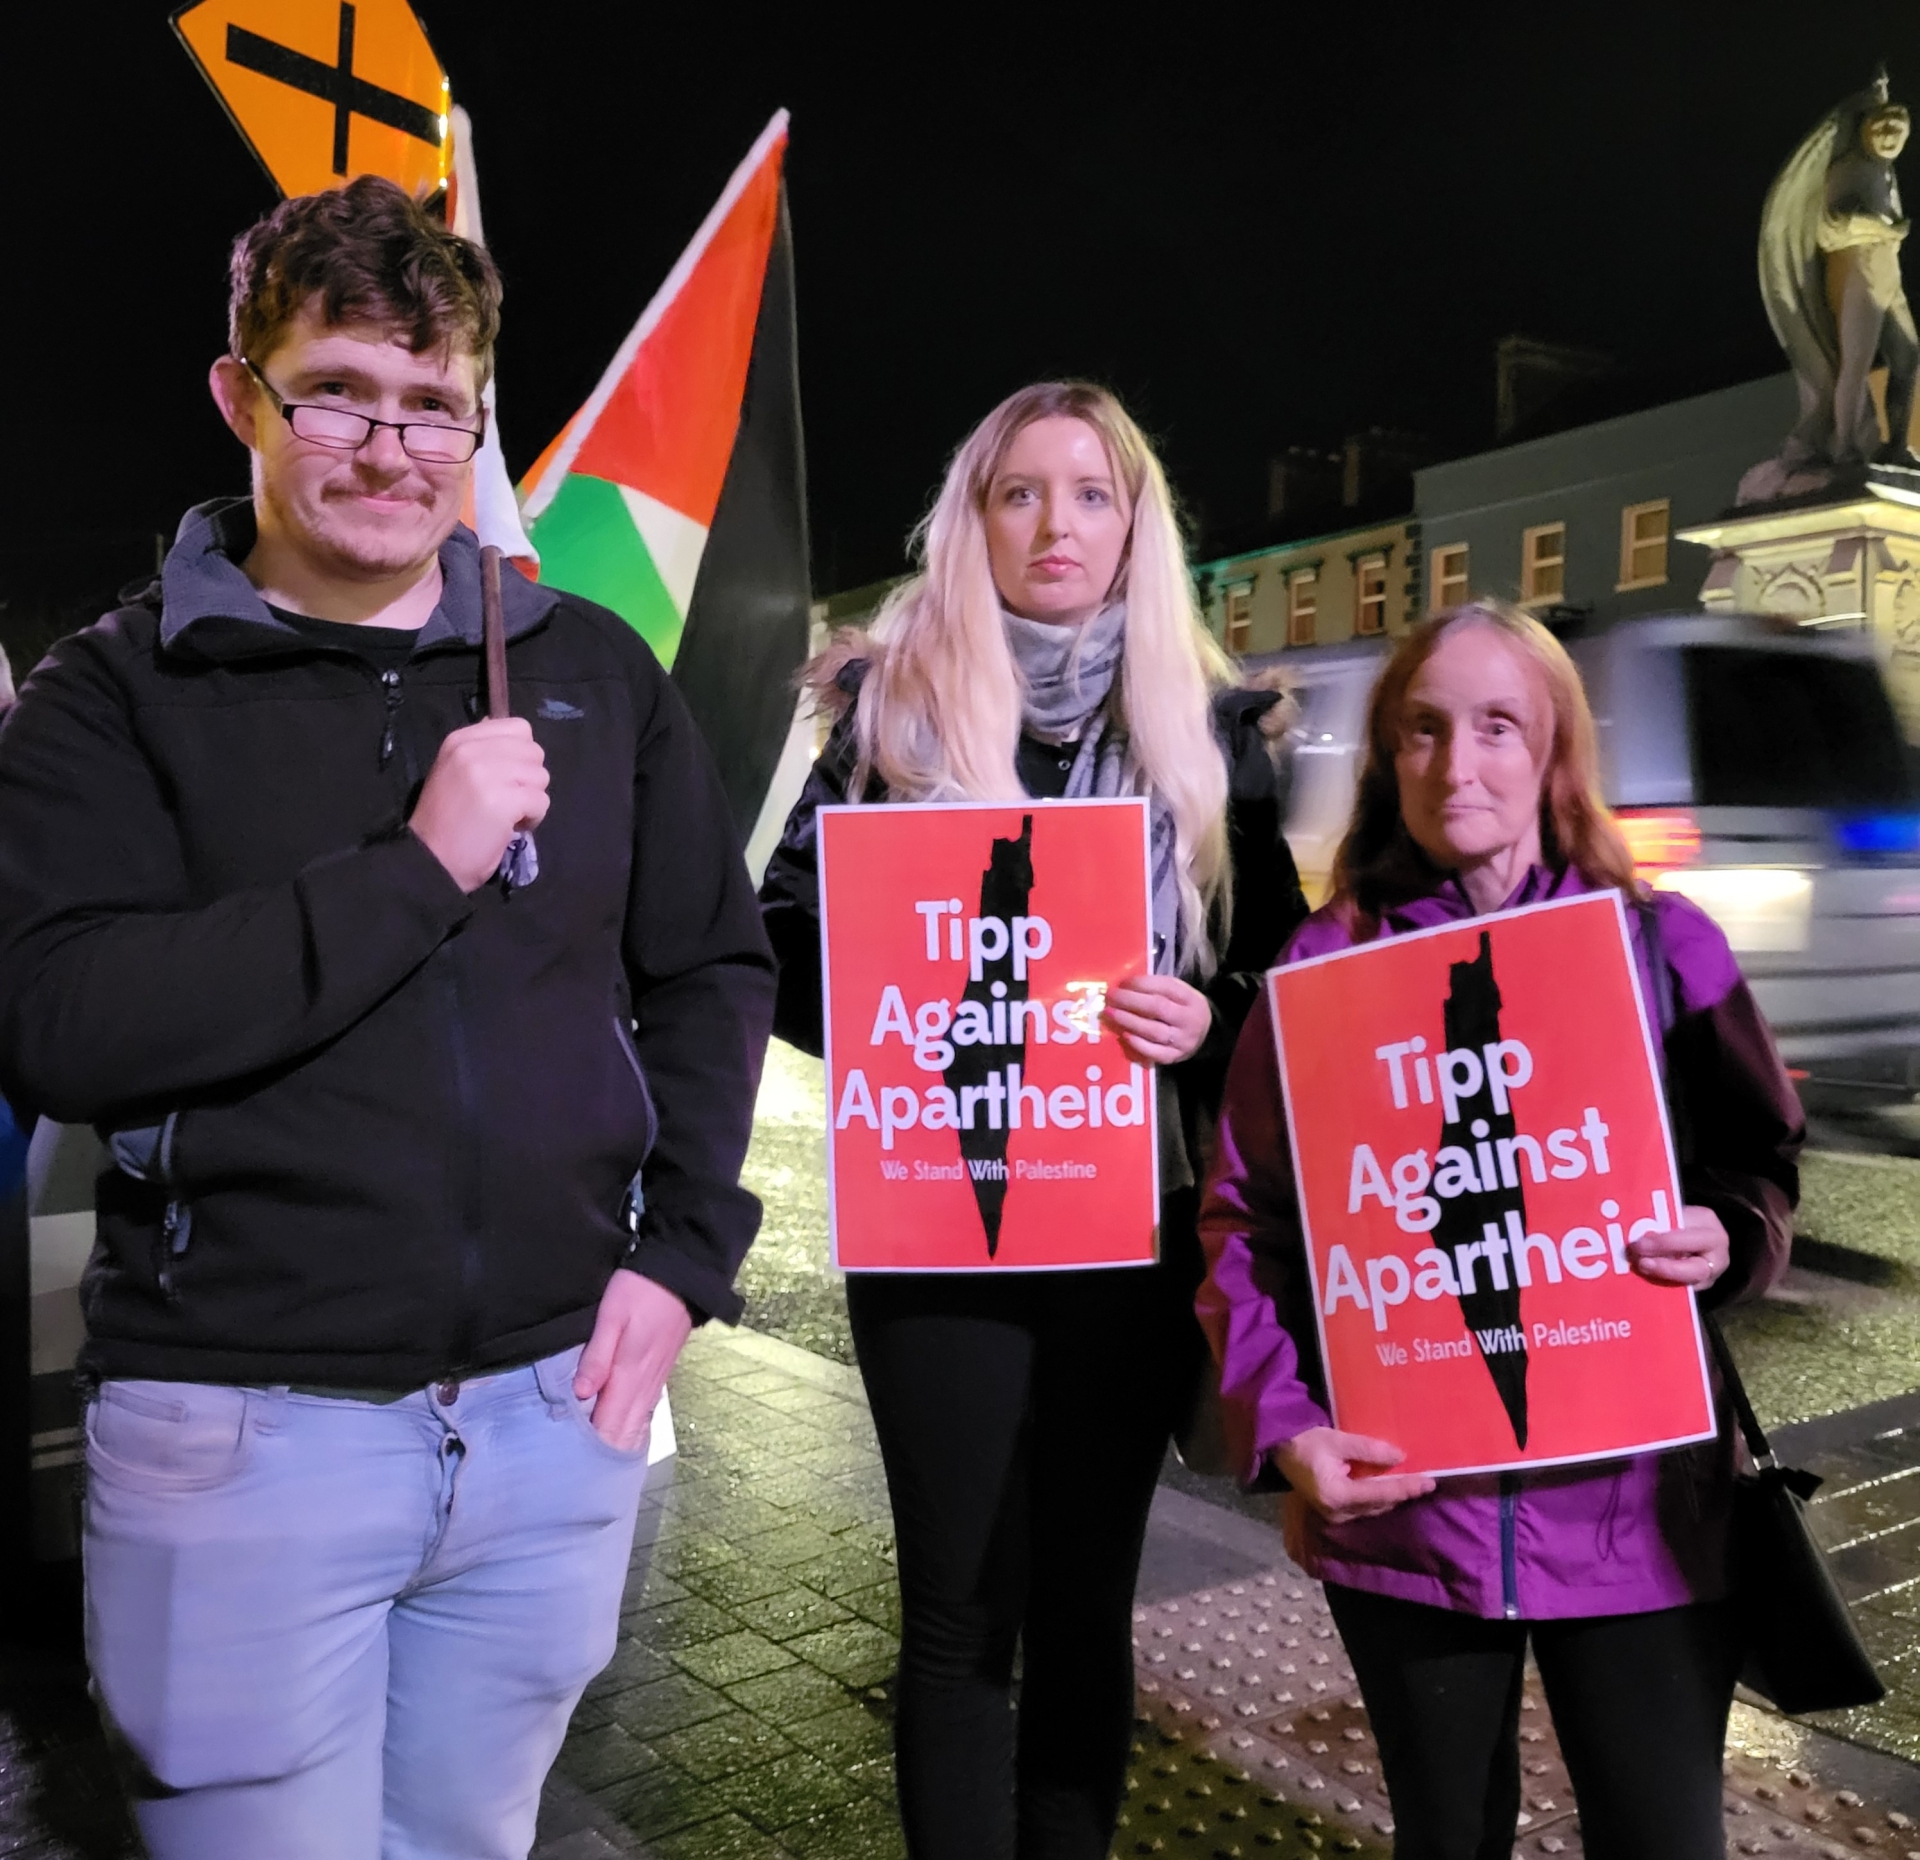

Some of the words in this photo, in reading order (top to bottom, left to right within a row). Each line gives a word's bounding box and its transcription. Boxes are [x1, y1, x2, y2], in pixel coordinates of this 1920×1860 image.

[914, 898, 1053, 981] Tipp
[870, 981, 1108, 1072] Against
[835, 1063, 1145, 1150] Apartheid
[1375, 1035, 1534, 1124] Tipp
[880, 1159, 909, 1180] We
[913, 1158, 963, 1181] Stand
[967, 1157, 1010, 1181] With
[1015, 1158, 1097, 1180] Palestine
[1347, 1106, 1610, 1233] Against
[1376, 1342, 1409, 1367] We
[1412, 1331, 1473, 1363] Stand
[1475, 1324, 1528, 1356] With
[1532, 1317, 1632, 1349] Palestine
